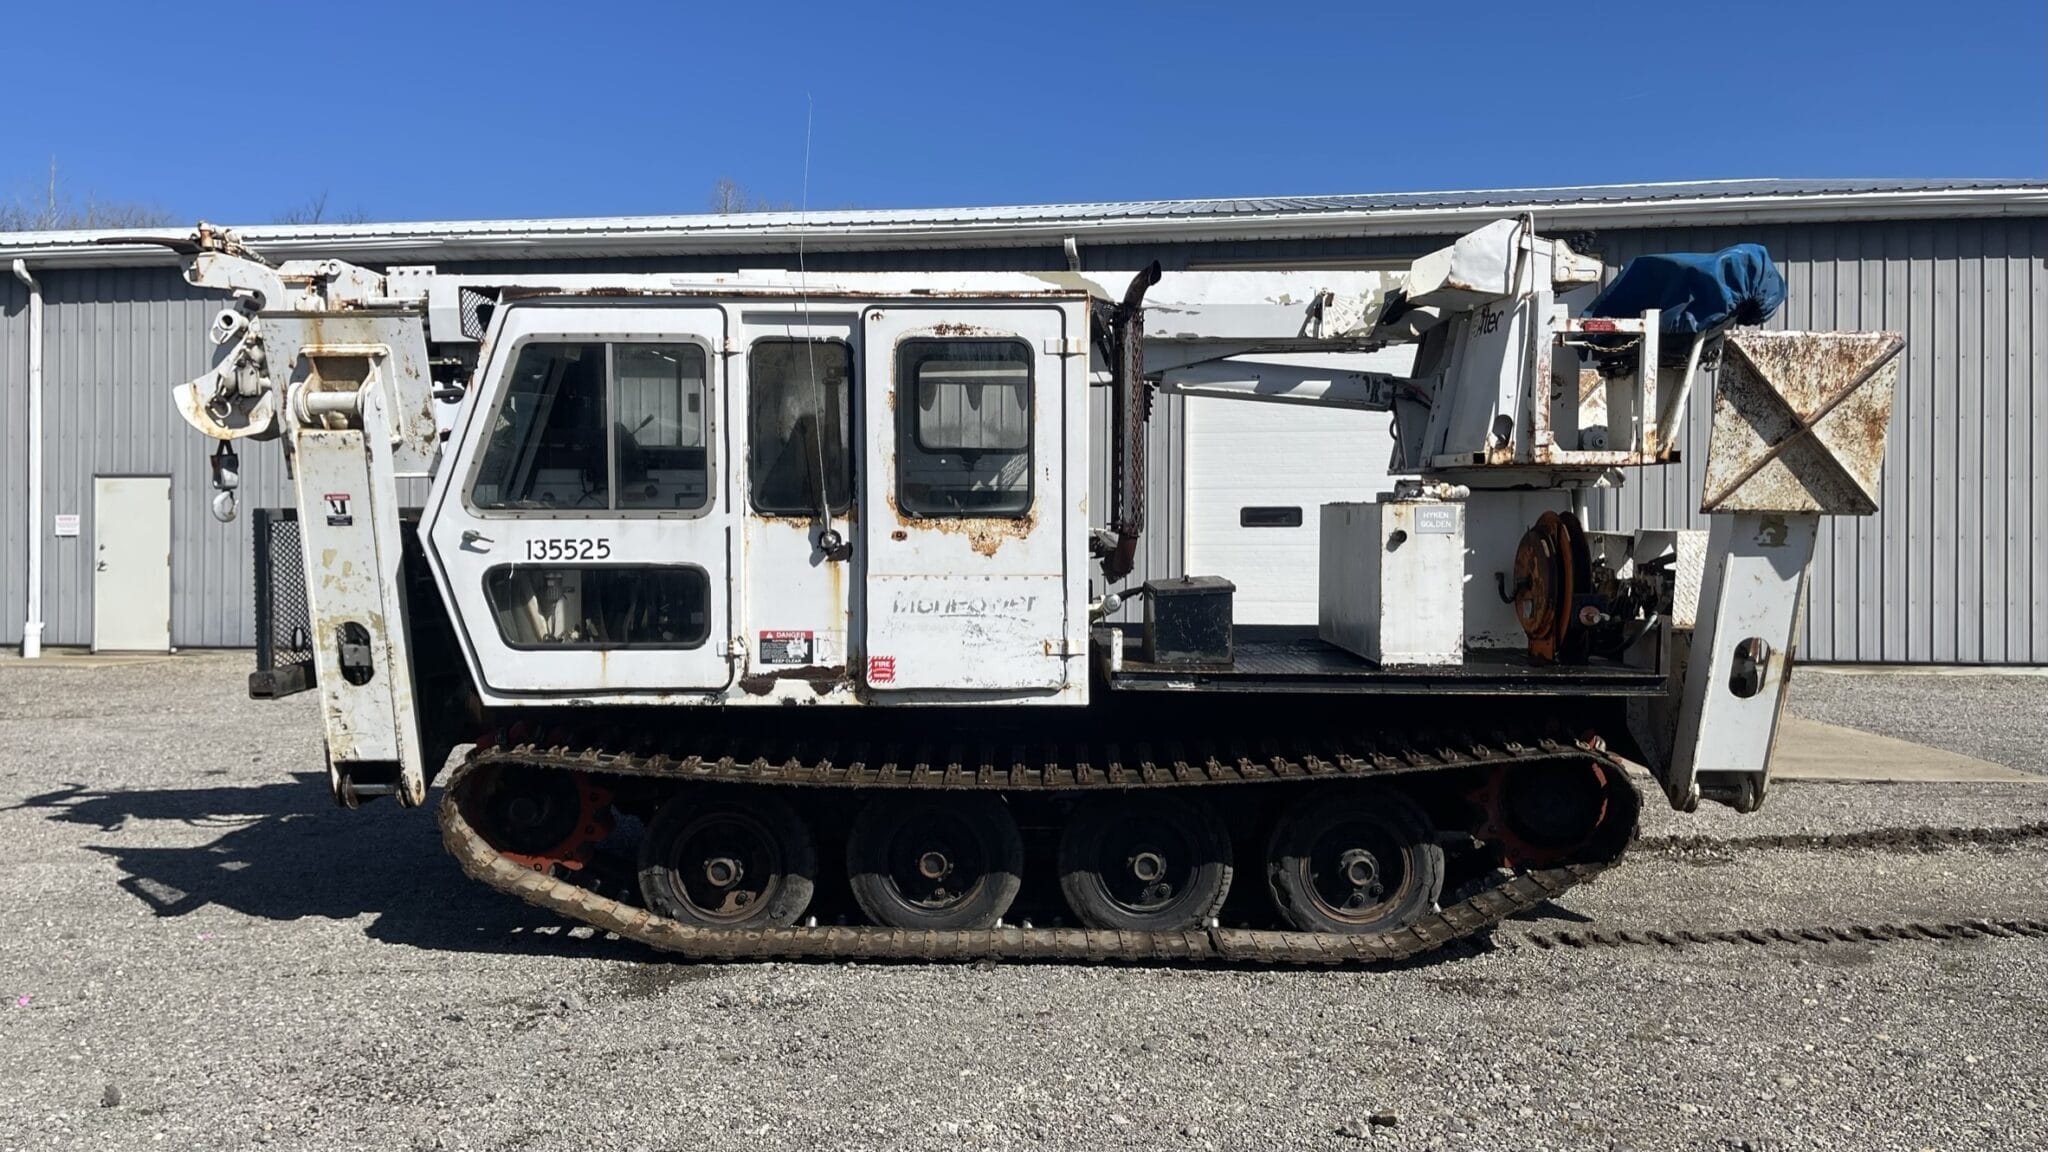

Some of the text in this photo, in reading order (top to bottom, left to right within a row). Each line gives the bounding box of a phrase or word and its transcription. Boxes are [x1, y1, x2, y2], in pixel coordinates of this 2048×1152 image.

[1420, 520, 1452, 528] GOLDEN
[526, 538, 611, 560] 135525
[776, 631, 806, 639] DANGER
[874, 660, 891, 668] FIRE
